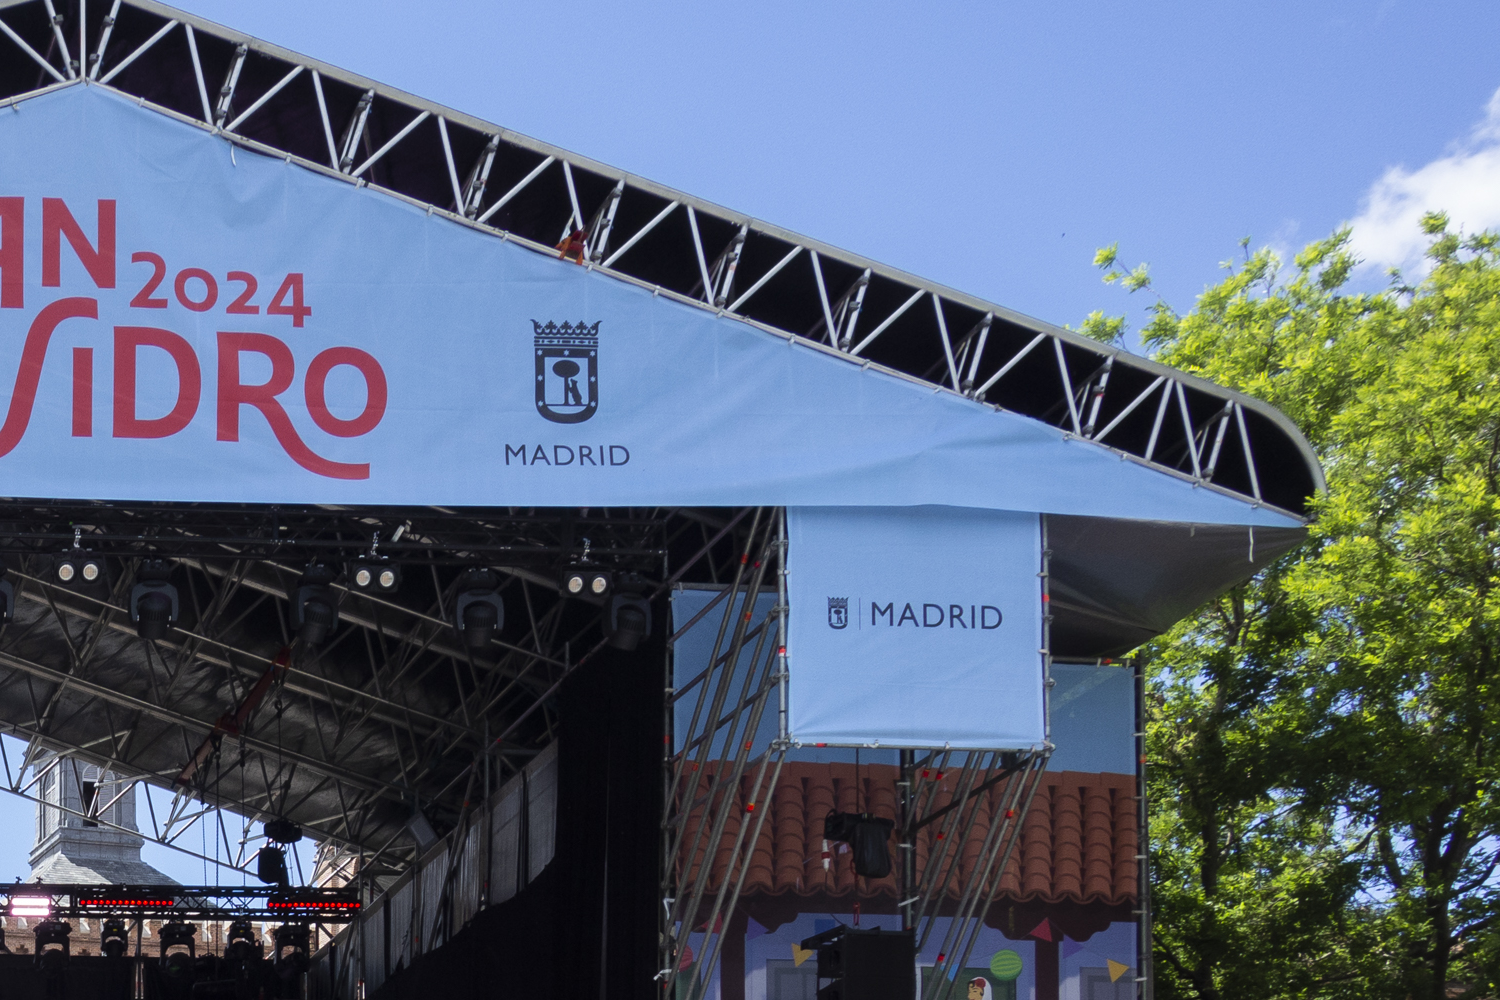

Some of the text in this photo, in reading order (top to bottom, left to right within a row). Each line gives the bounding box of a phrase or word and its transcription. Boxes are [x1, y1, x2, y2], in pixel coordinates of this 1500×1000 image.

[130, 252, 311, 327] 2024
[505, 443, 630, 466] MADRID
[871, 601, 1003, 630] MADRID
